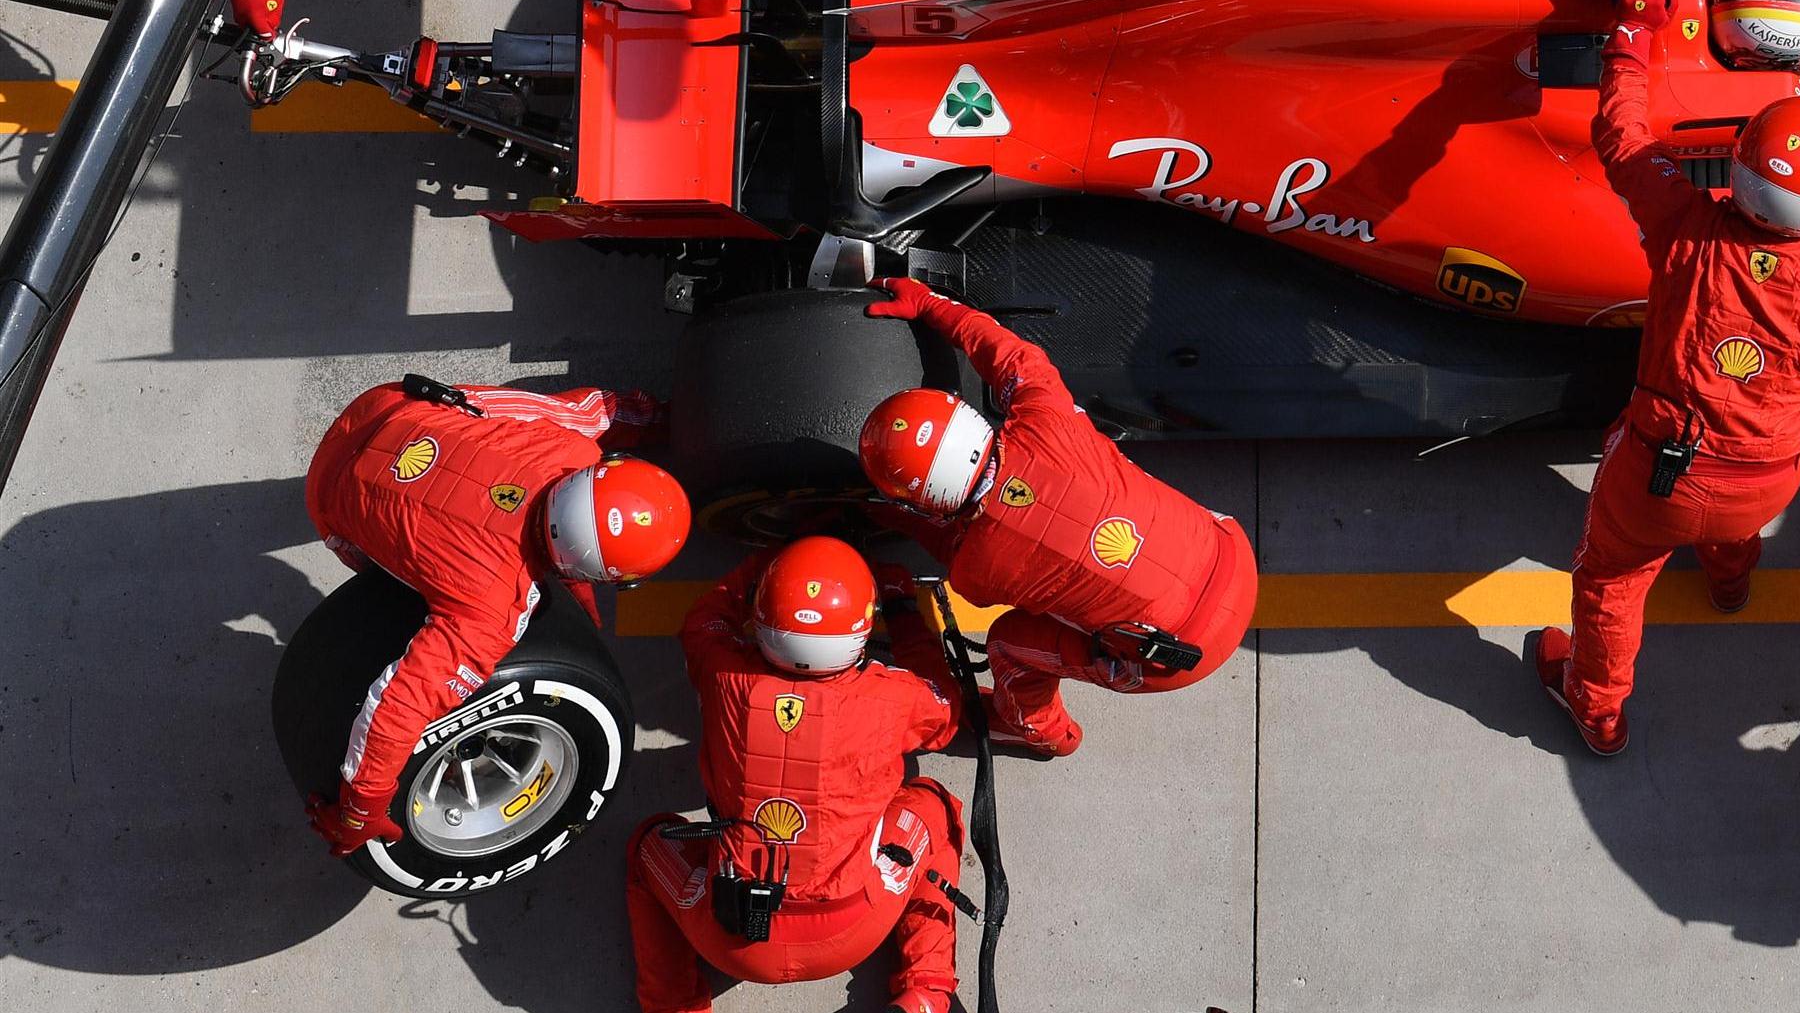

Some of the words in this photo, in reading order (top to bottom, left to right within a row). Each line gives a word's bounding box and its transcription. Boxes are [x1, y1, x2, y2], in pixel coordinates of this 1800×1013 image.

[912, 6, 957, 35] 5
[1108, 137, 1377, 243] Ray-Ban
[1443, 268, 1517, 315] ups
[586, 789, 605, 821] P
[424, 829, 571, 893] ZERO
